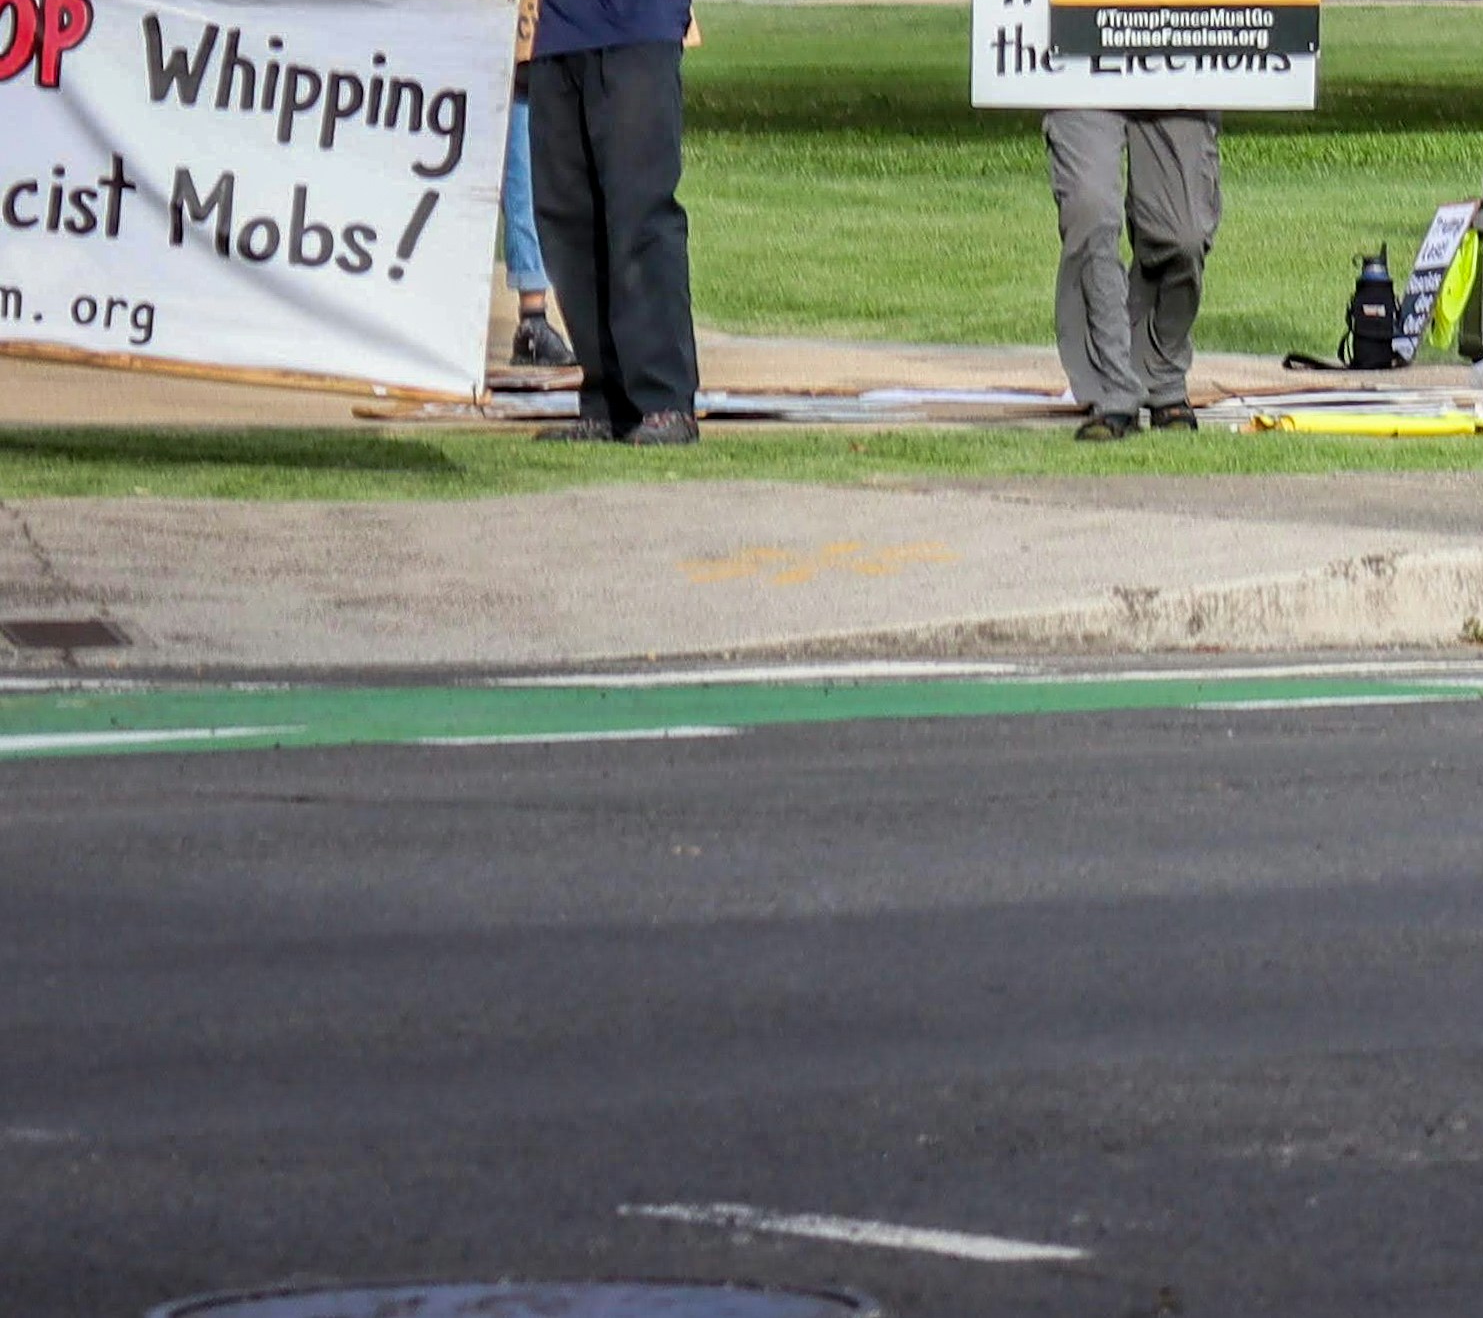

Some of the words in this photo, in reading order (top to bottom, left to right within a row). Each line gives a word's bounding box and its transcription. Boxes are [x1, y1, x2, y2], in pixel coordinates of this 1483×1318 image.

[1096, 8, 1274, 30] #TrumpPenceMustGo
[1101, 27, 1270, 50] RefuseFascism.org
[141, 11, 468, 179] Whipping
[2, 153, 137, 239] cist
[168, 166, 441, 283] Mobs!
